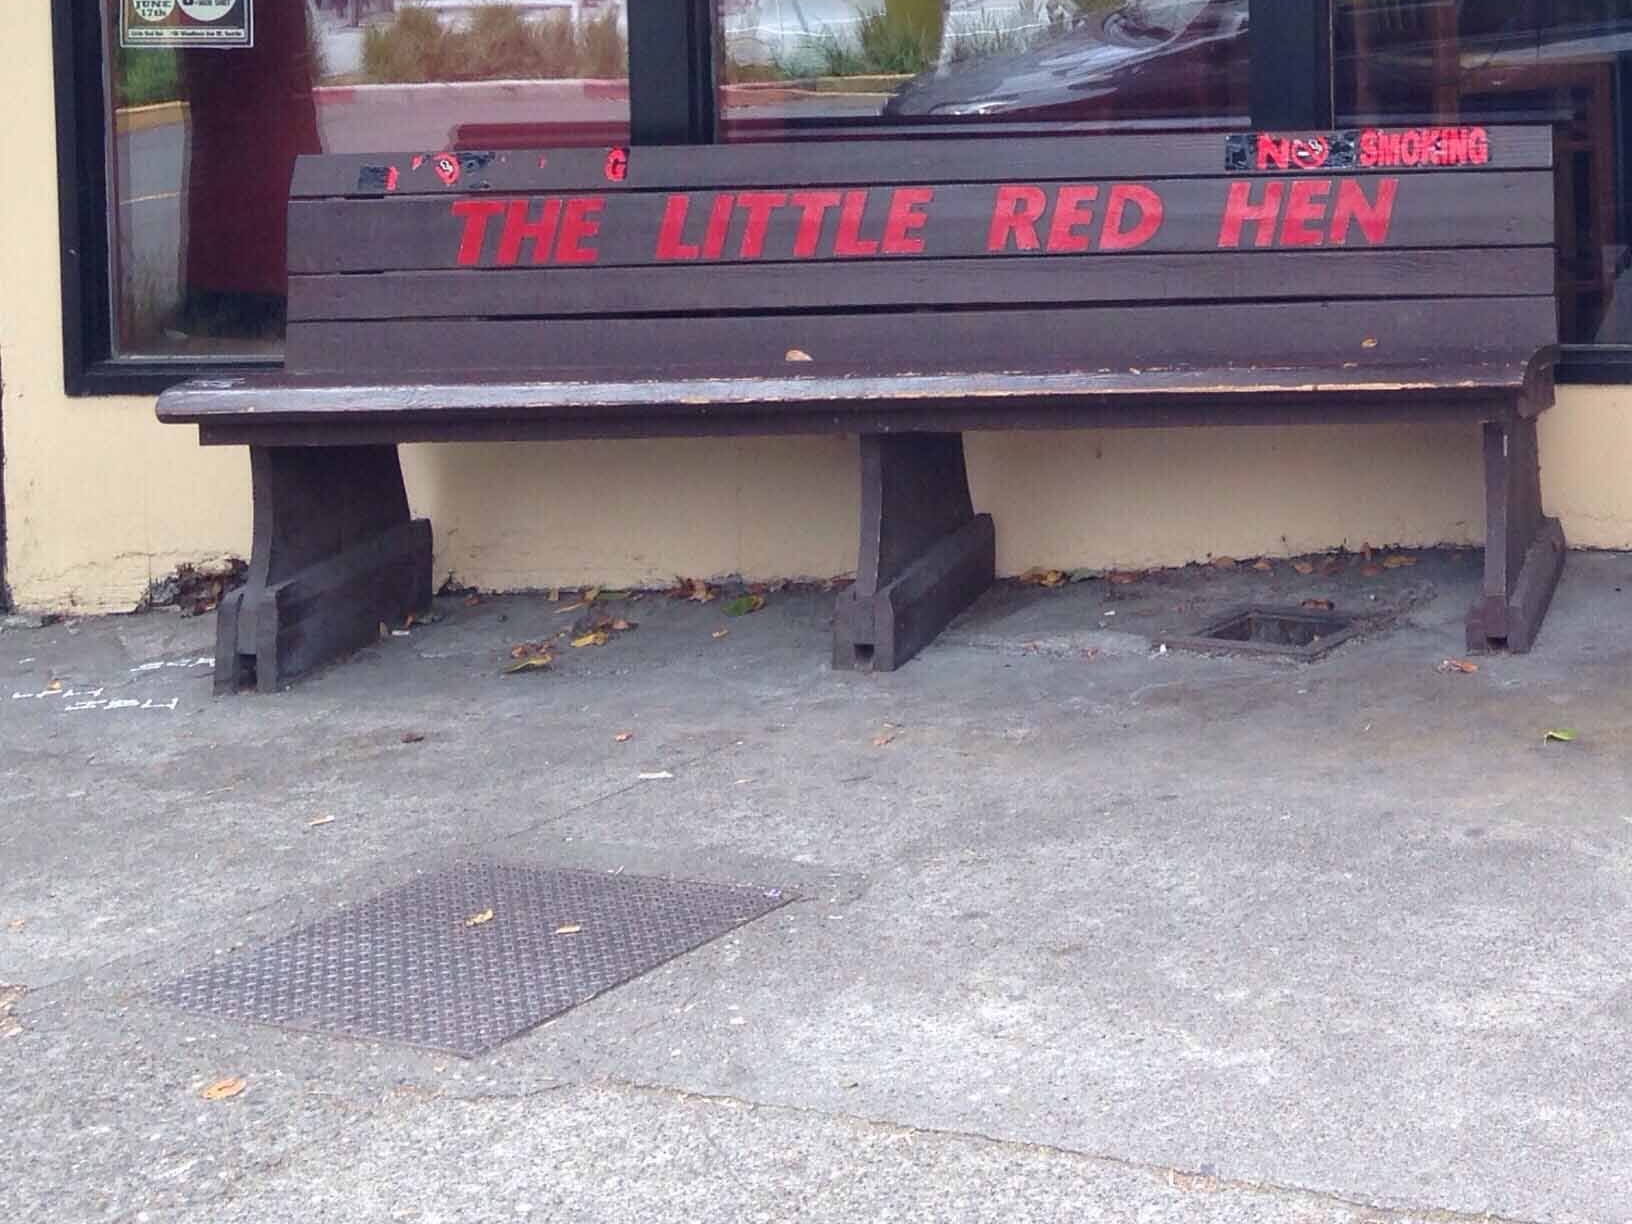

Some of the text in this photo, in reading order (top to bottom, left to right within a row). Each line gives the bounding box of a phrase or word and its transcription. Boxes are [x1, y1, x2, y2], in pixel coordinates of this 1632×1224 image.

[1359, 127, 1488, 167] SMOKING
[452, 178, 1398, 265] THE LITTLE RED HEN
